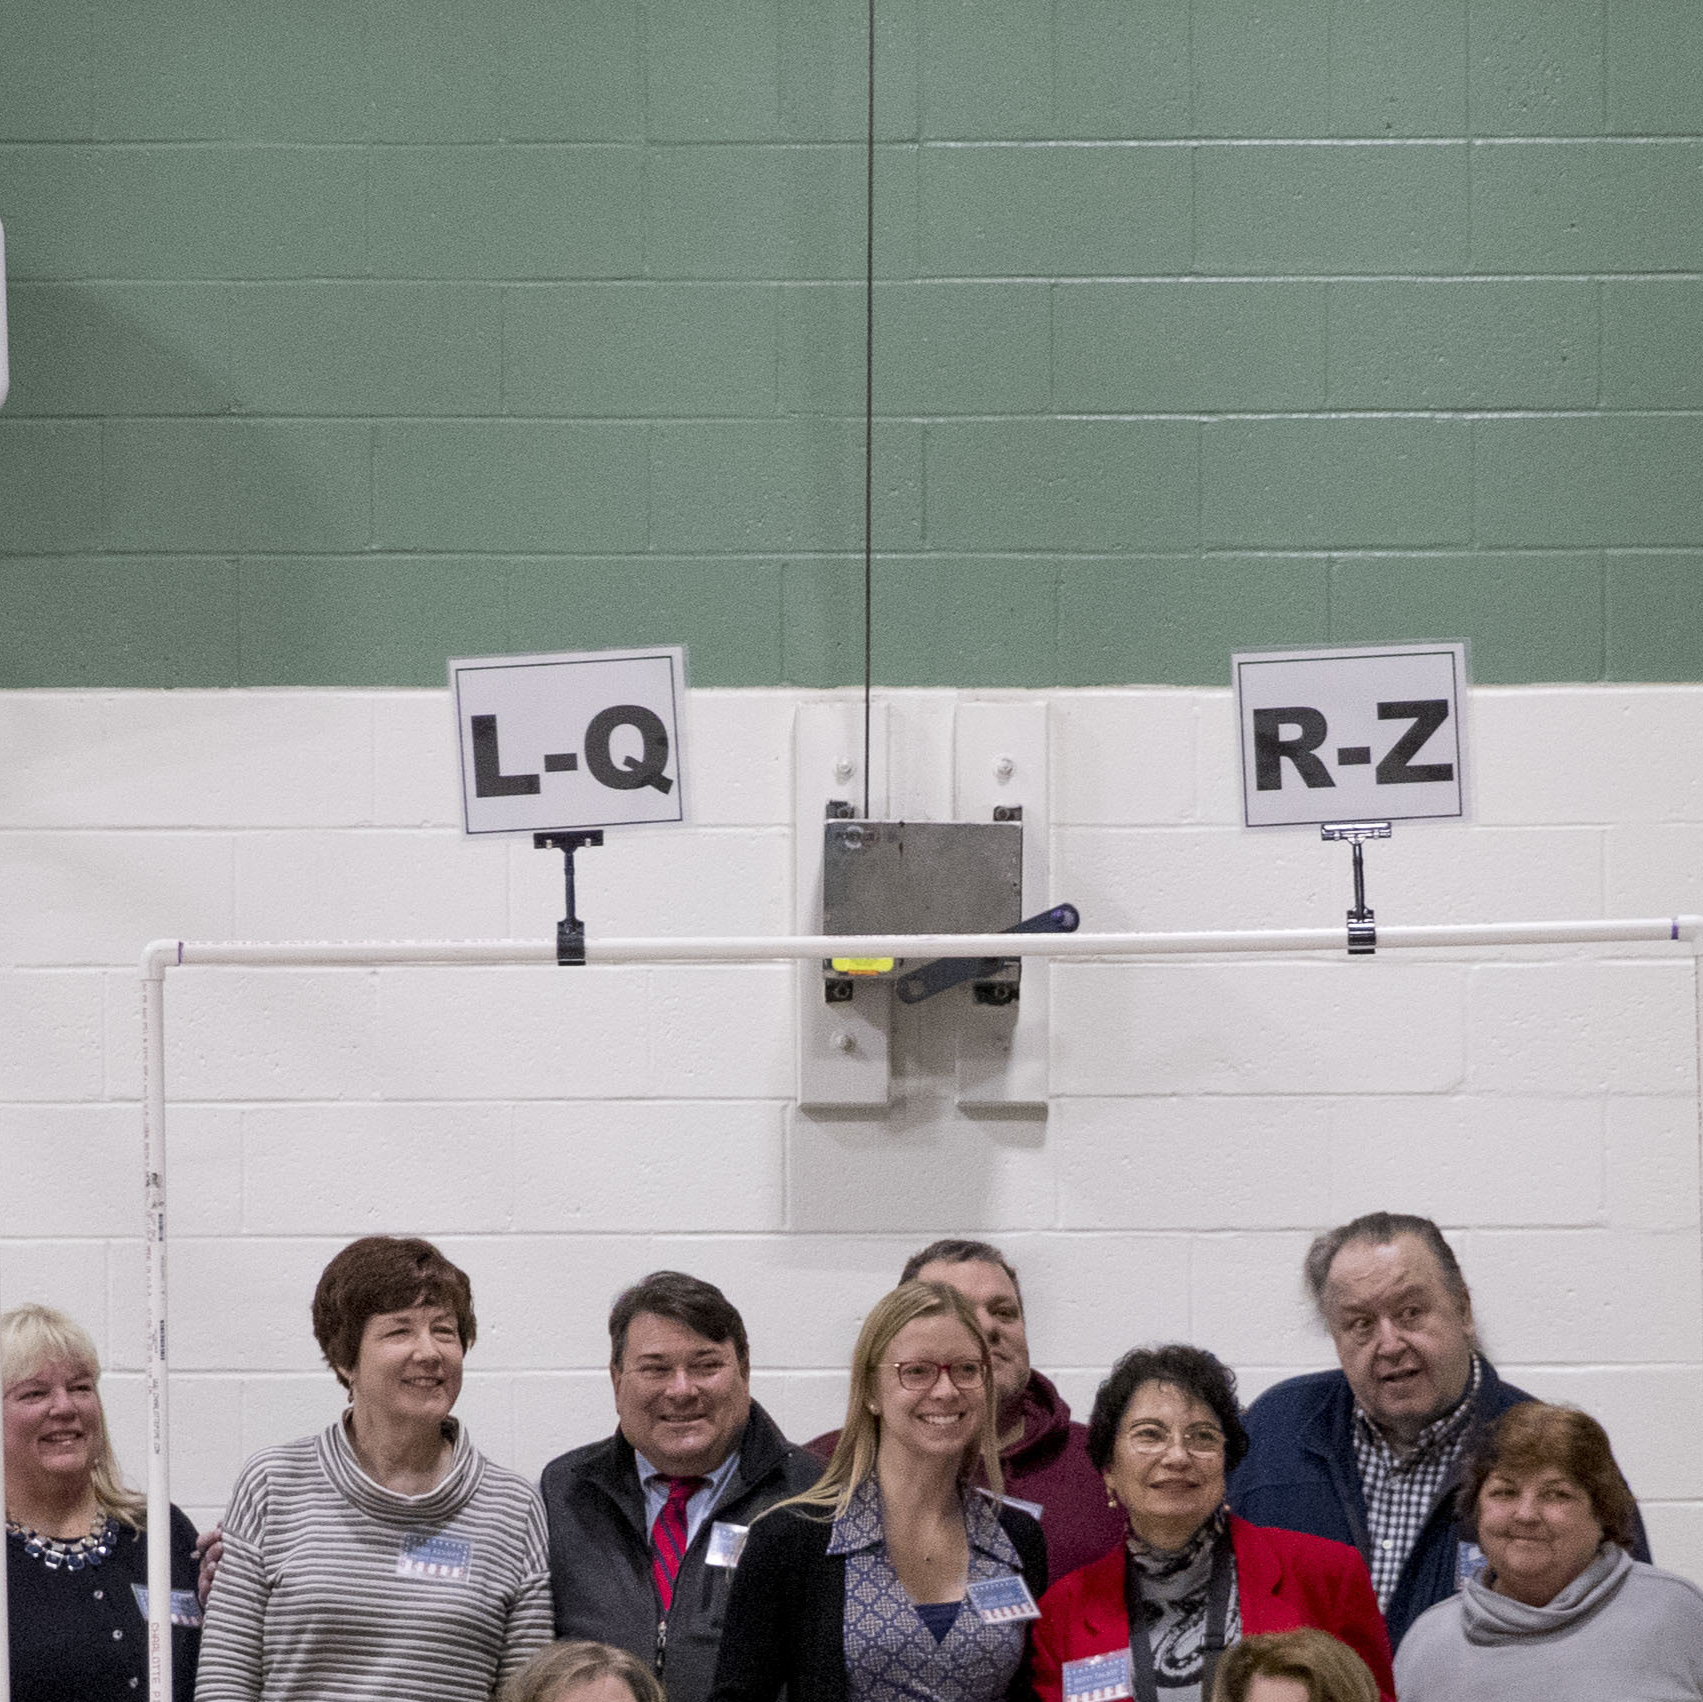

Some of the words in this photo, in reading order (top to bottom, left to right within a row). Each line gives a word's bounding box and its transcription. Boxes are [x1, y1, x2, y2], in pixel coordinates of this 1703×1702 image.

[471, 704, 672, 797] L-Q
[1253, 699, 1453, 791] R-Z
[150, 1622, 161, 1684] CHARLOTTE
